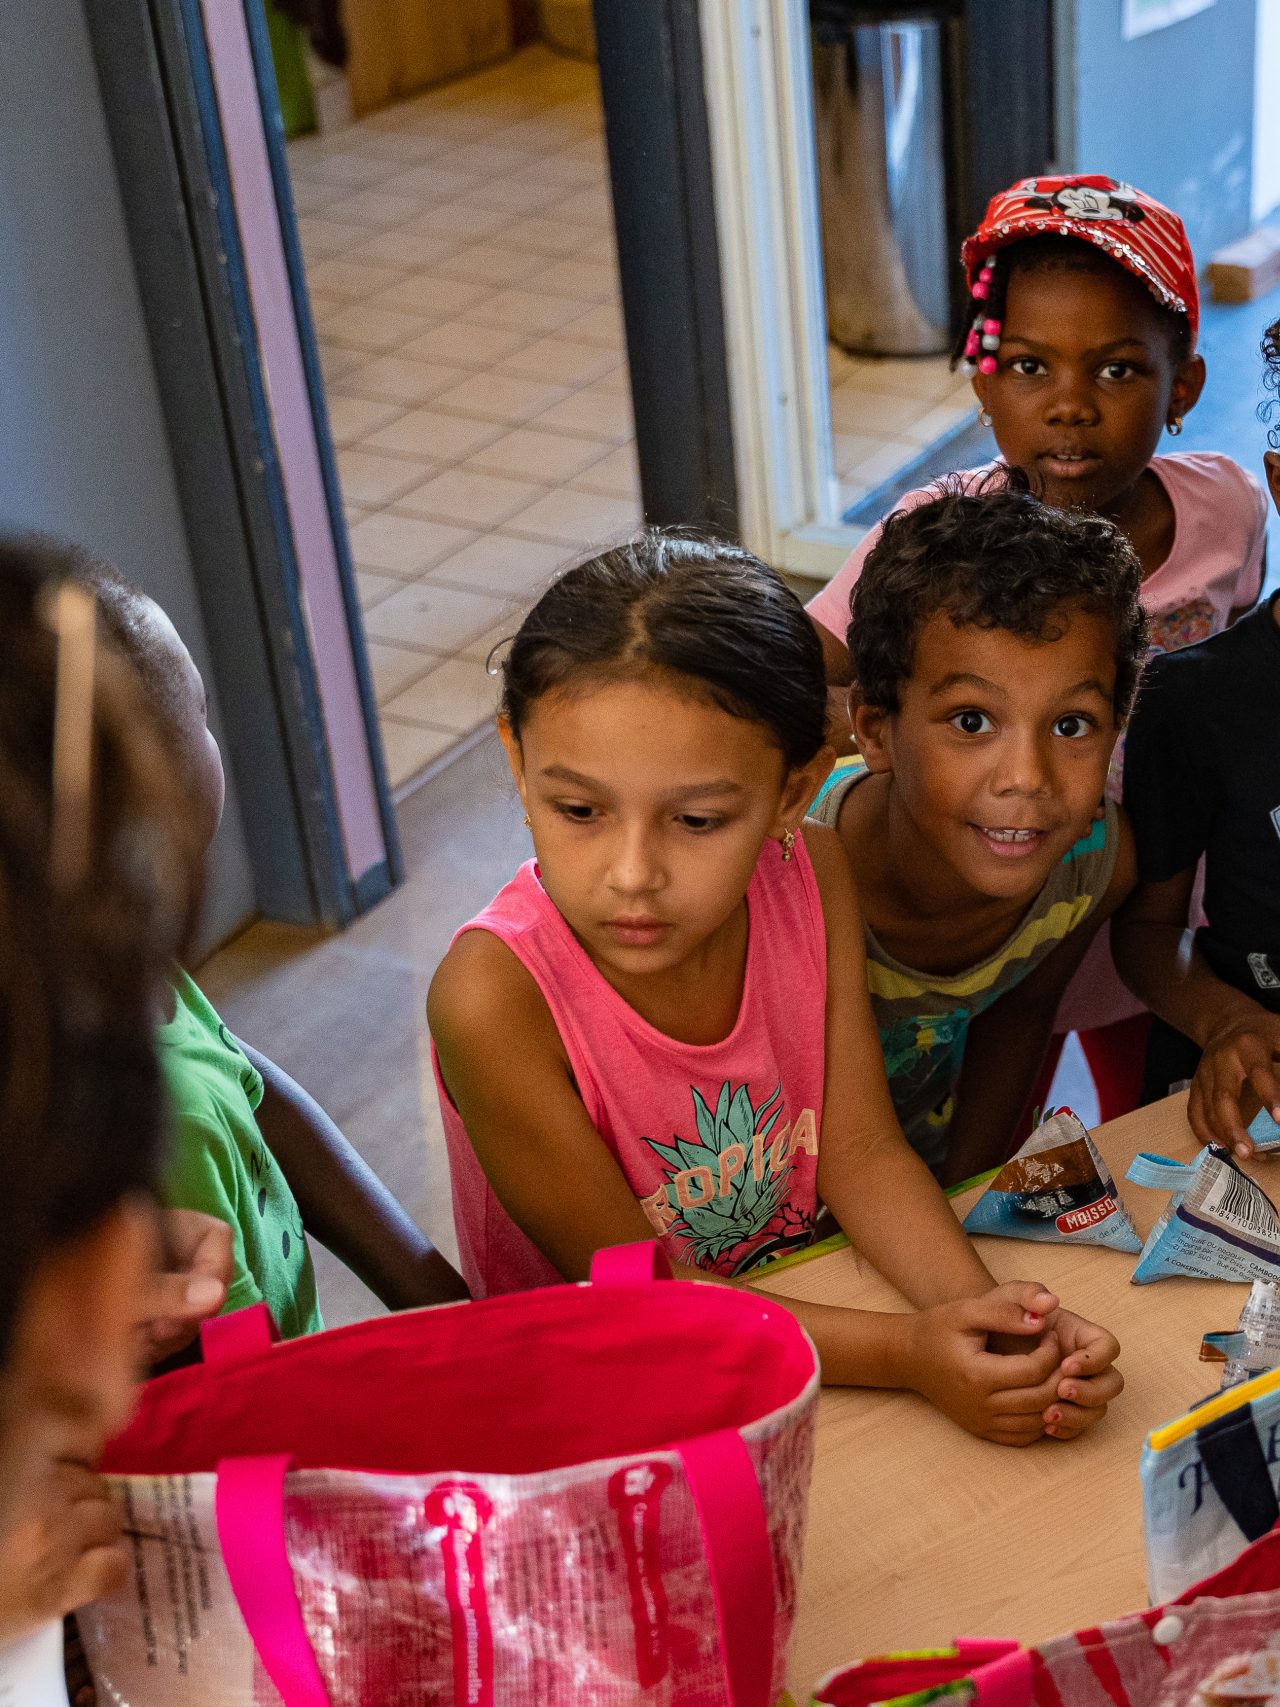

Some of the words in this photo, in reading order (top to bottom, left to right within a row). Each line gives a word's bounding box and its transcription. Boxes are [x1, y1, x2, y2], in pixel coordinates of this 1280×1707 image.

[1180, 1231, 1207, 1245] ORIGINE
[1217, 1247, 1246, 1262] PRODUIT
[1171, 1259, 1208, 1276] CONSERVER
[1180, 1248, 1196, 1257] PORT
[1216, 1260, 1228, 1269] Rue
